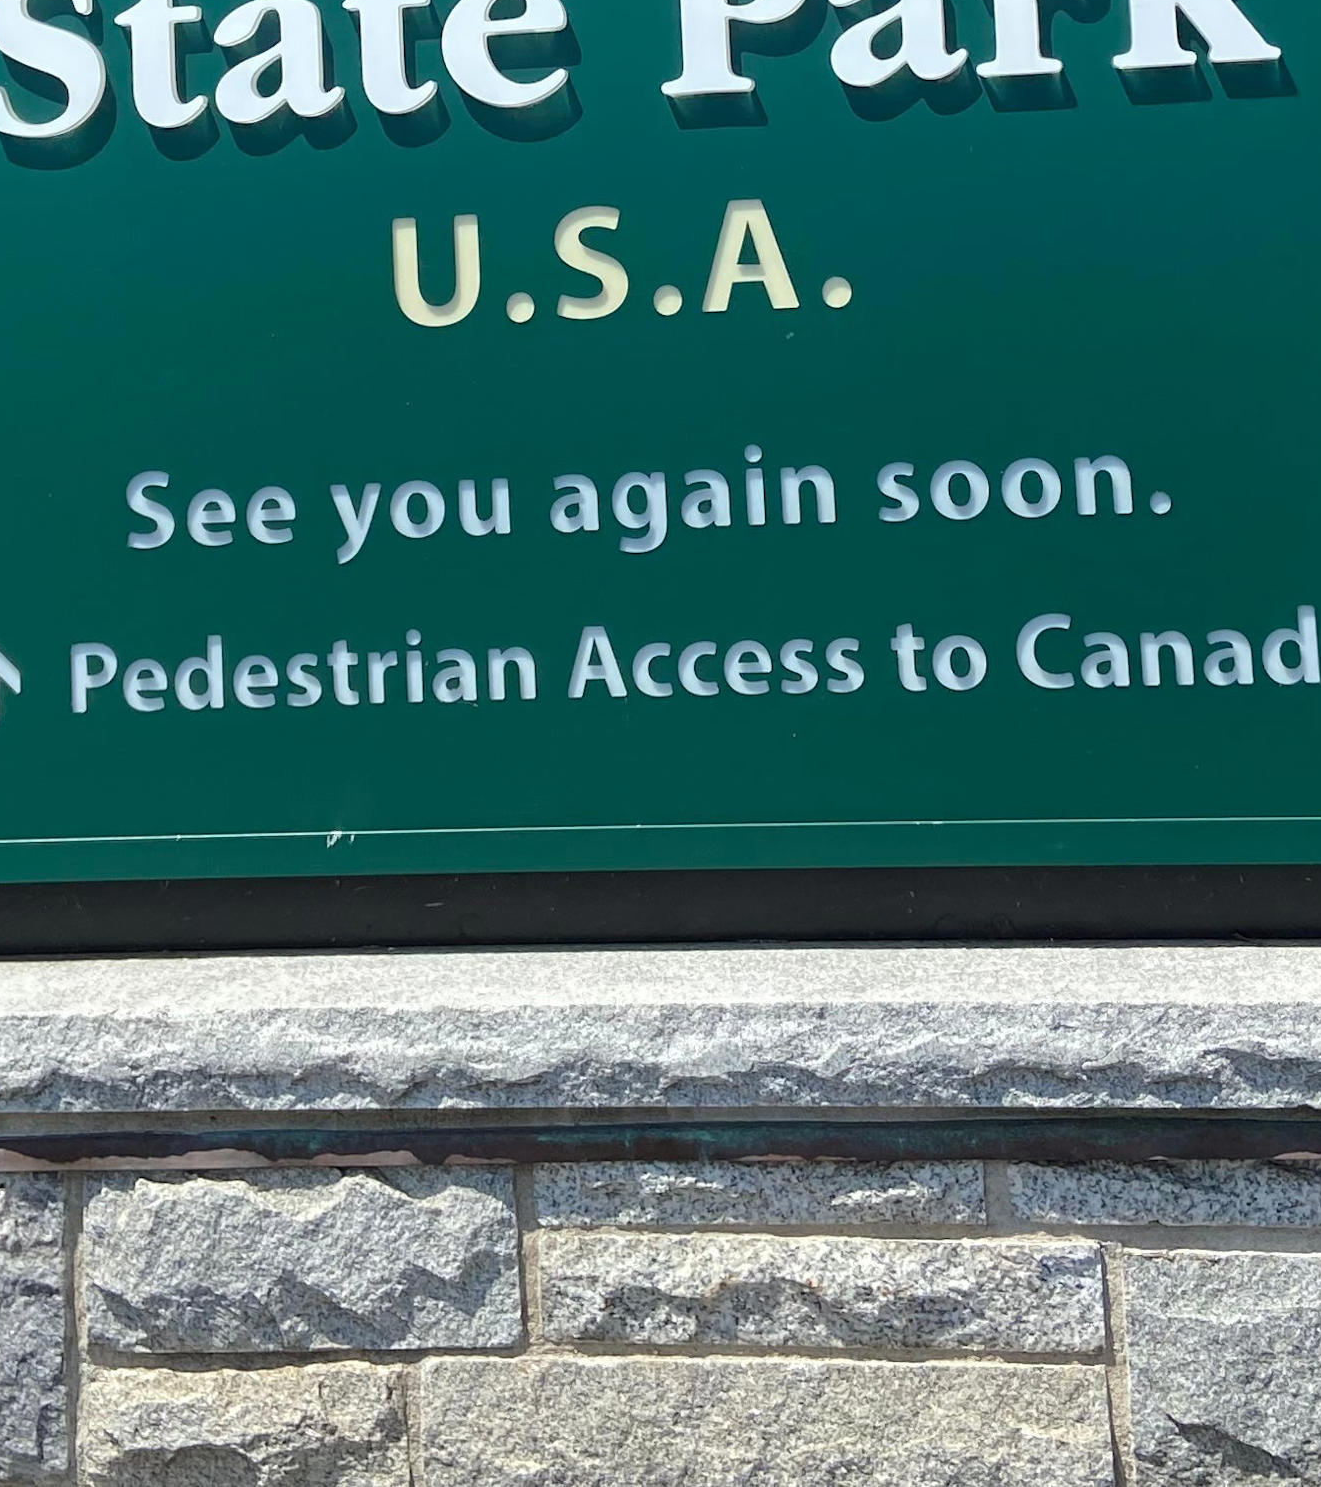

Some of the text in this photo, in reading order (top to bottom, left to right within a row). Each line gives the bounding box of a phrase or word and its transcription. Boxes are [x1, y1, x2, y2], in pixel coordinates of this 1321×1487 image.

[392, 199, 852, 328] U.S.A.
[128, 445, 1172, 564] See you again soon.
[71, 629, 537, 714] Pedestrian
[569, 627, 865, 698] Access
[893, 625, 987, 692] to
